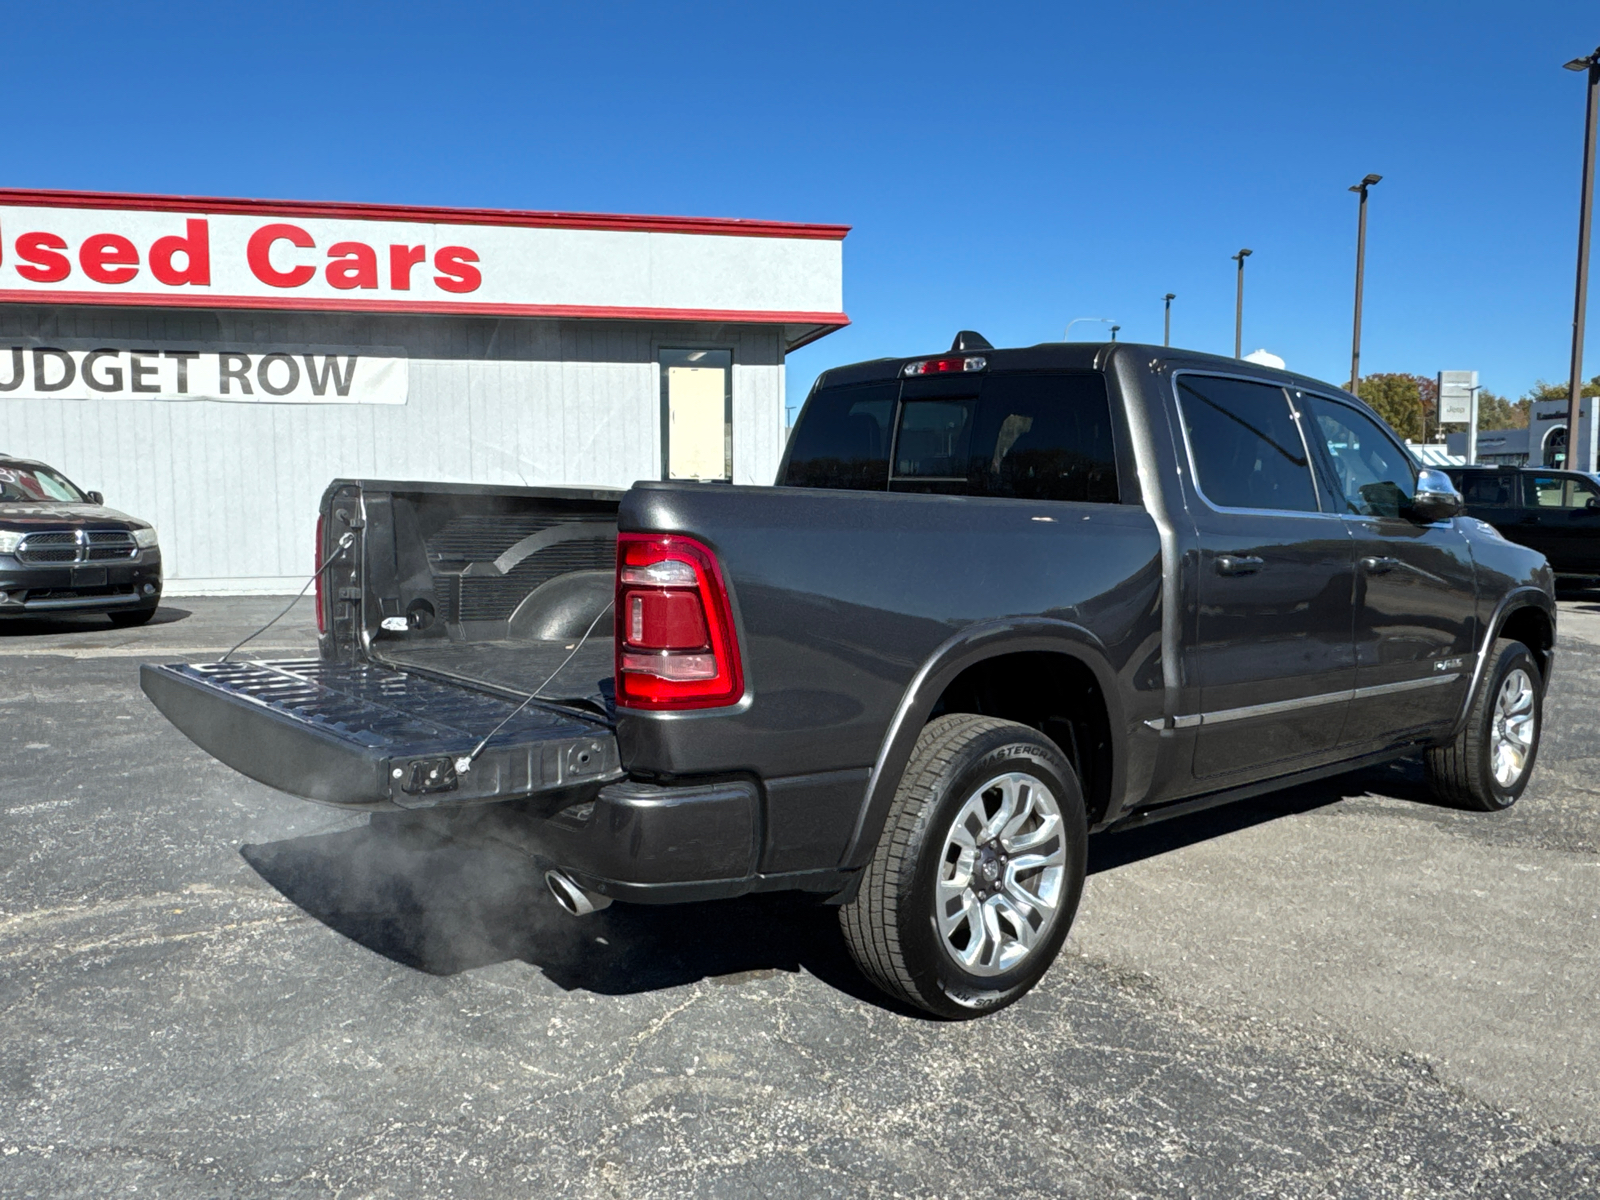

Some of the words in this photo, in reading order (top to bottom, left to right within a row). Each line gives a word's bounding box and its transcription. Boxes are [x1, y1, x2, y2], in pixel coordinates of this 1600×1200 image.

[0, 218, 211, 287] sed
[246, 223, 483, 294] Cars
[218, 351, 359, 397] ROW
[1446, 405, 1466, 414] Jeep
